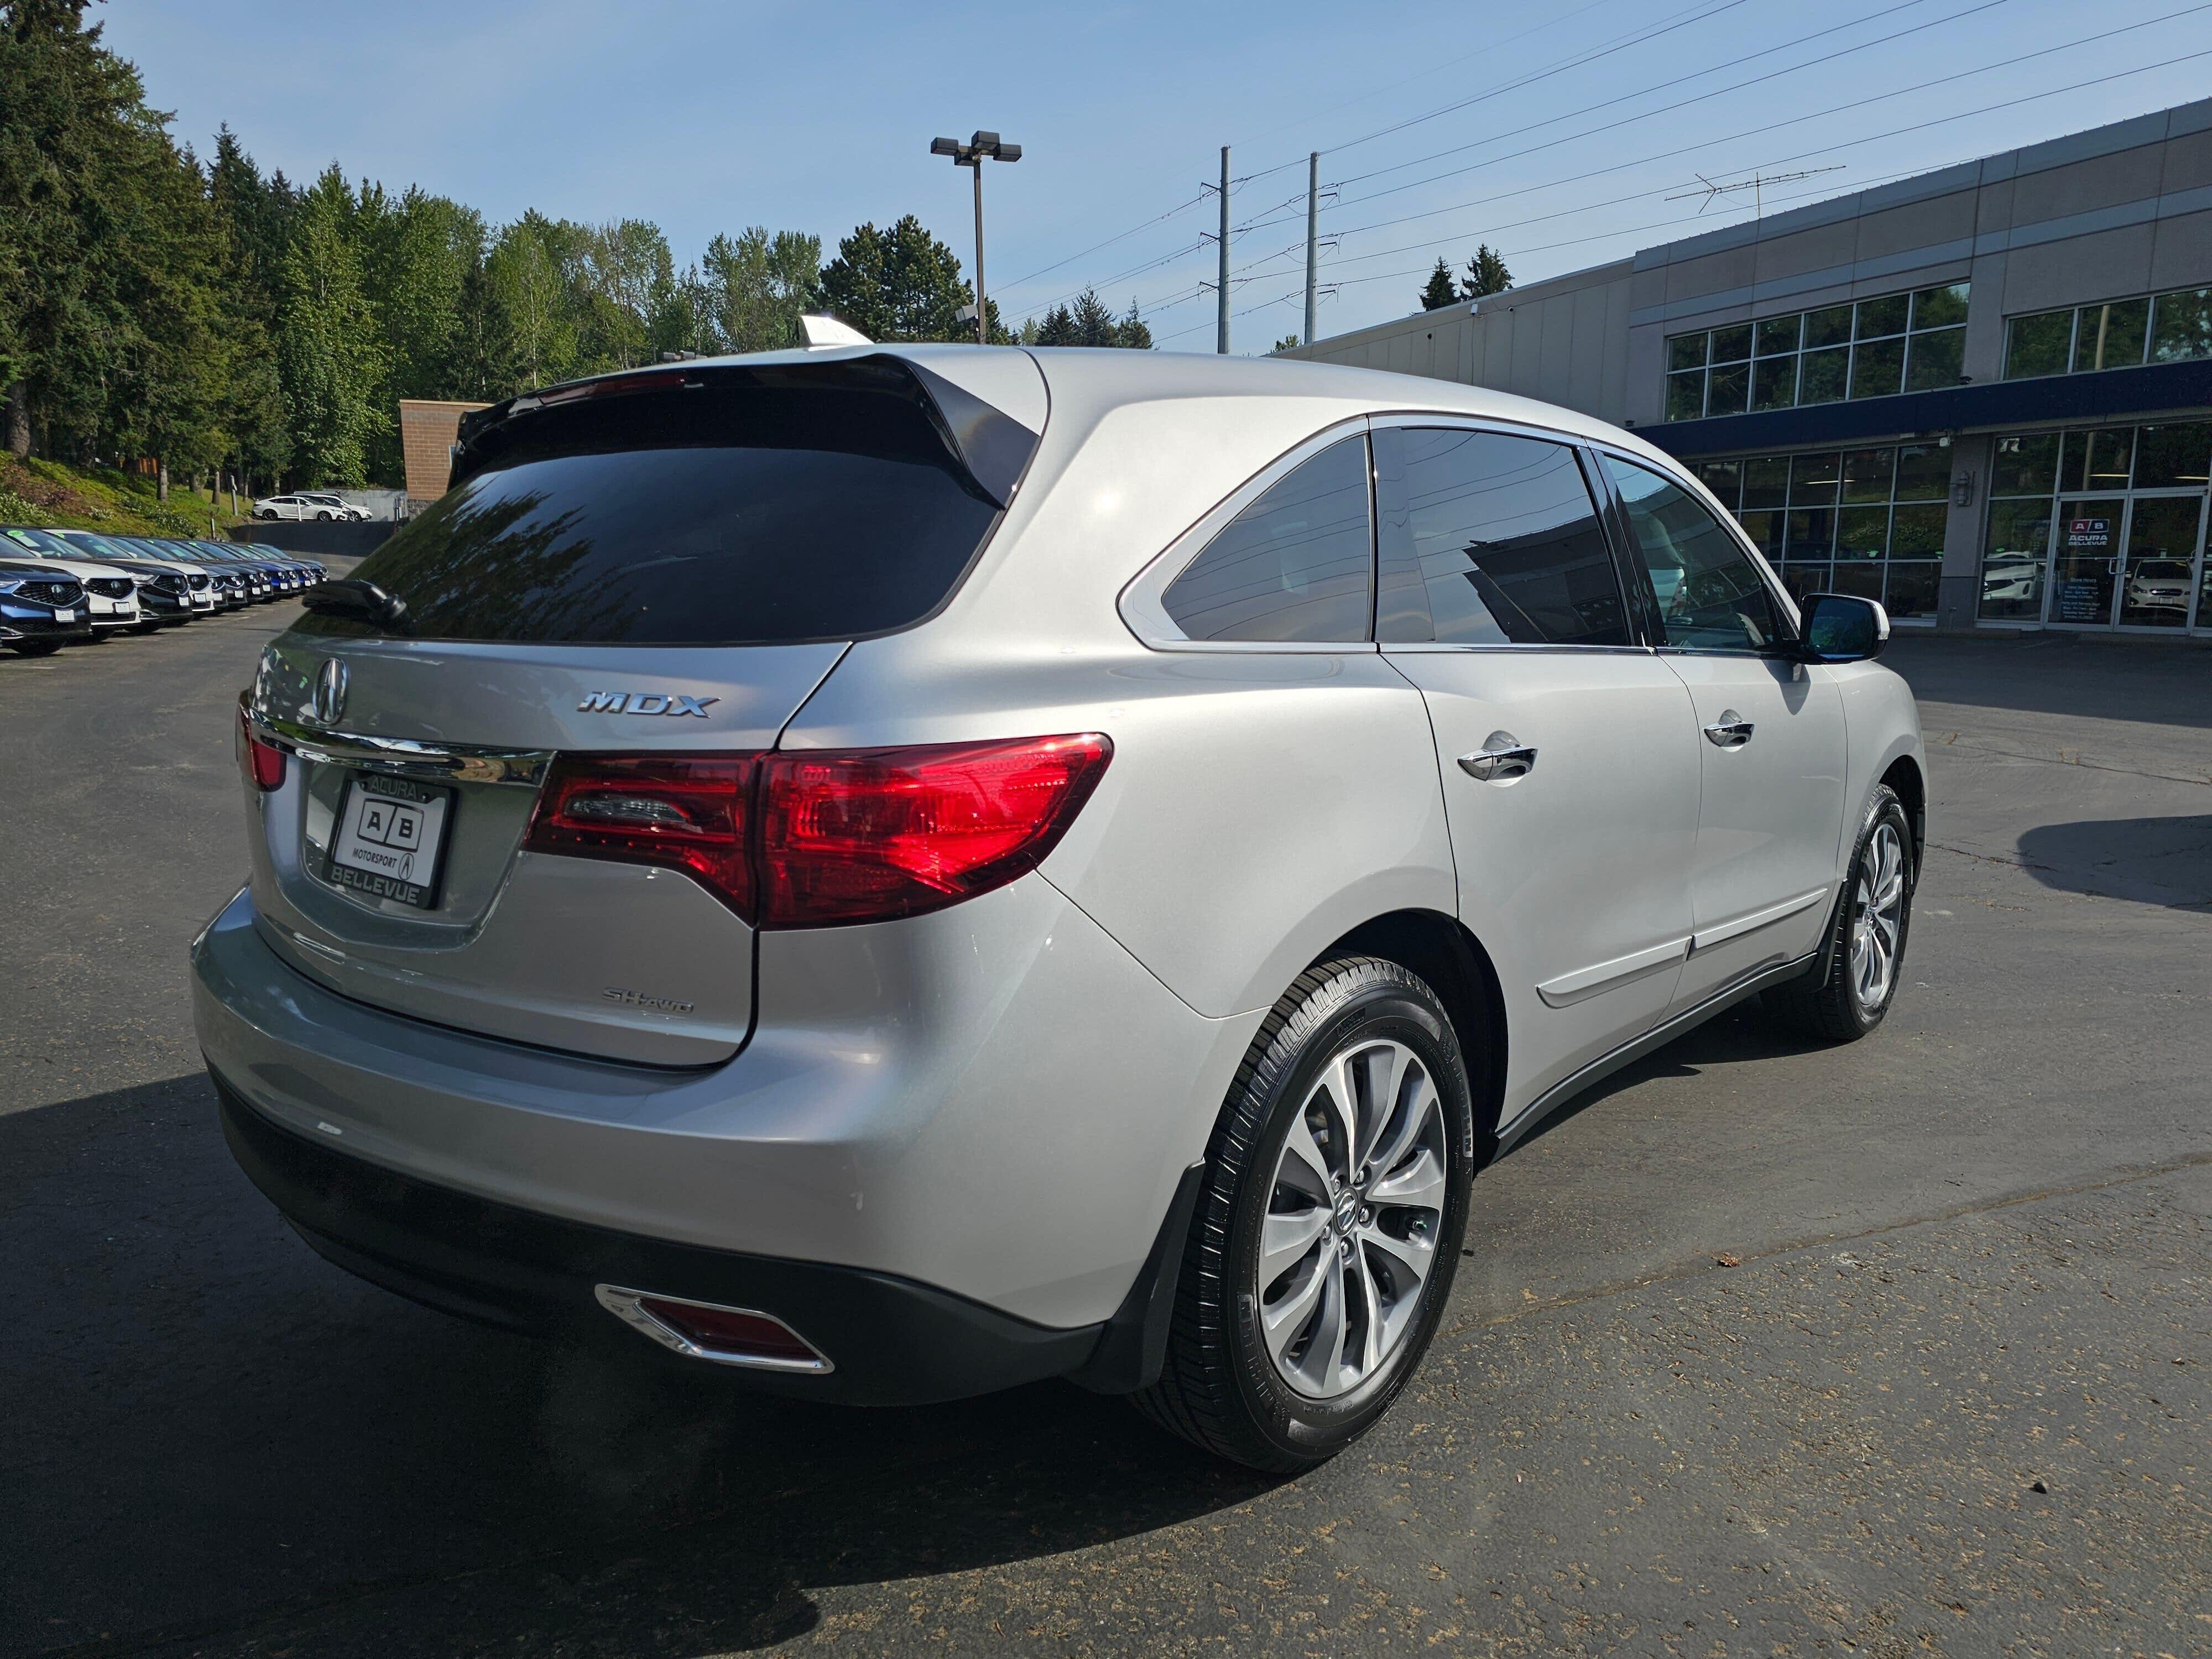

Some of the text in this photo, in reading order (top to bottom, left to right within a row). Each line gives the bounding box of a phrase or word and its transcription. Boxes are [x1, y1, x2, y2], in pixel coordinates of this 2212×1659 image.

[576, 691, 722, 719] MDX
[369, 775, 418, 799] ACURA
[367, 811, 414, 839] A B
[352, 847, 398, 869] MOTORSPORT
[331, 865, 420, 905] BELLEVUE
